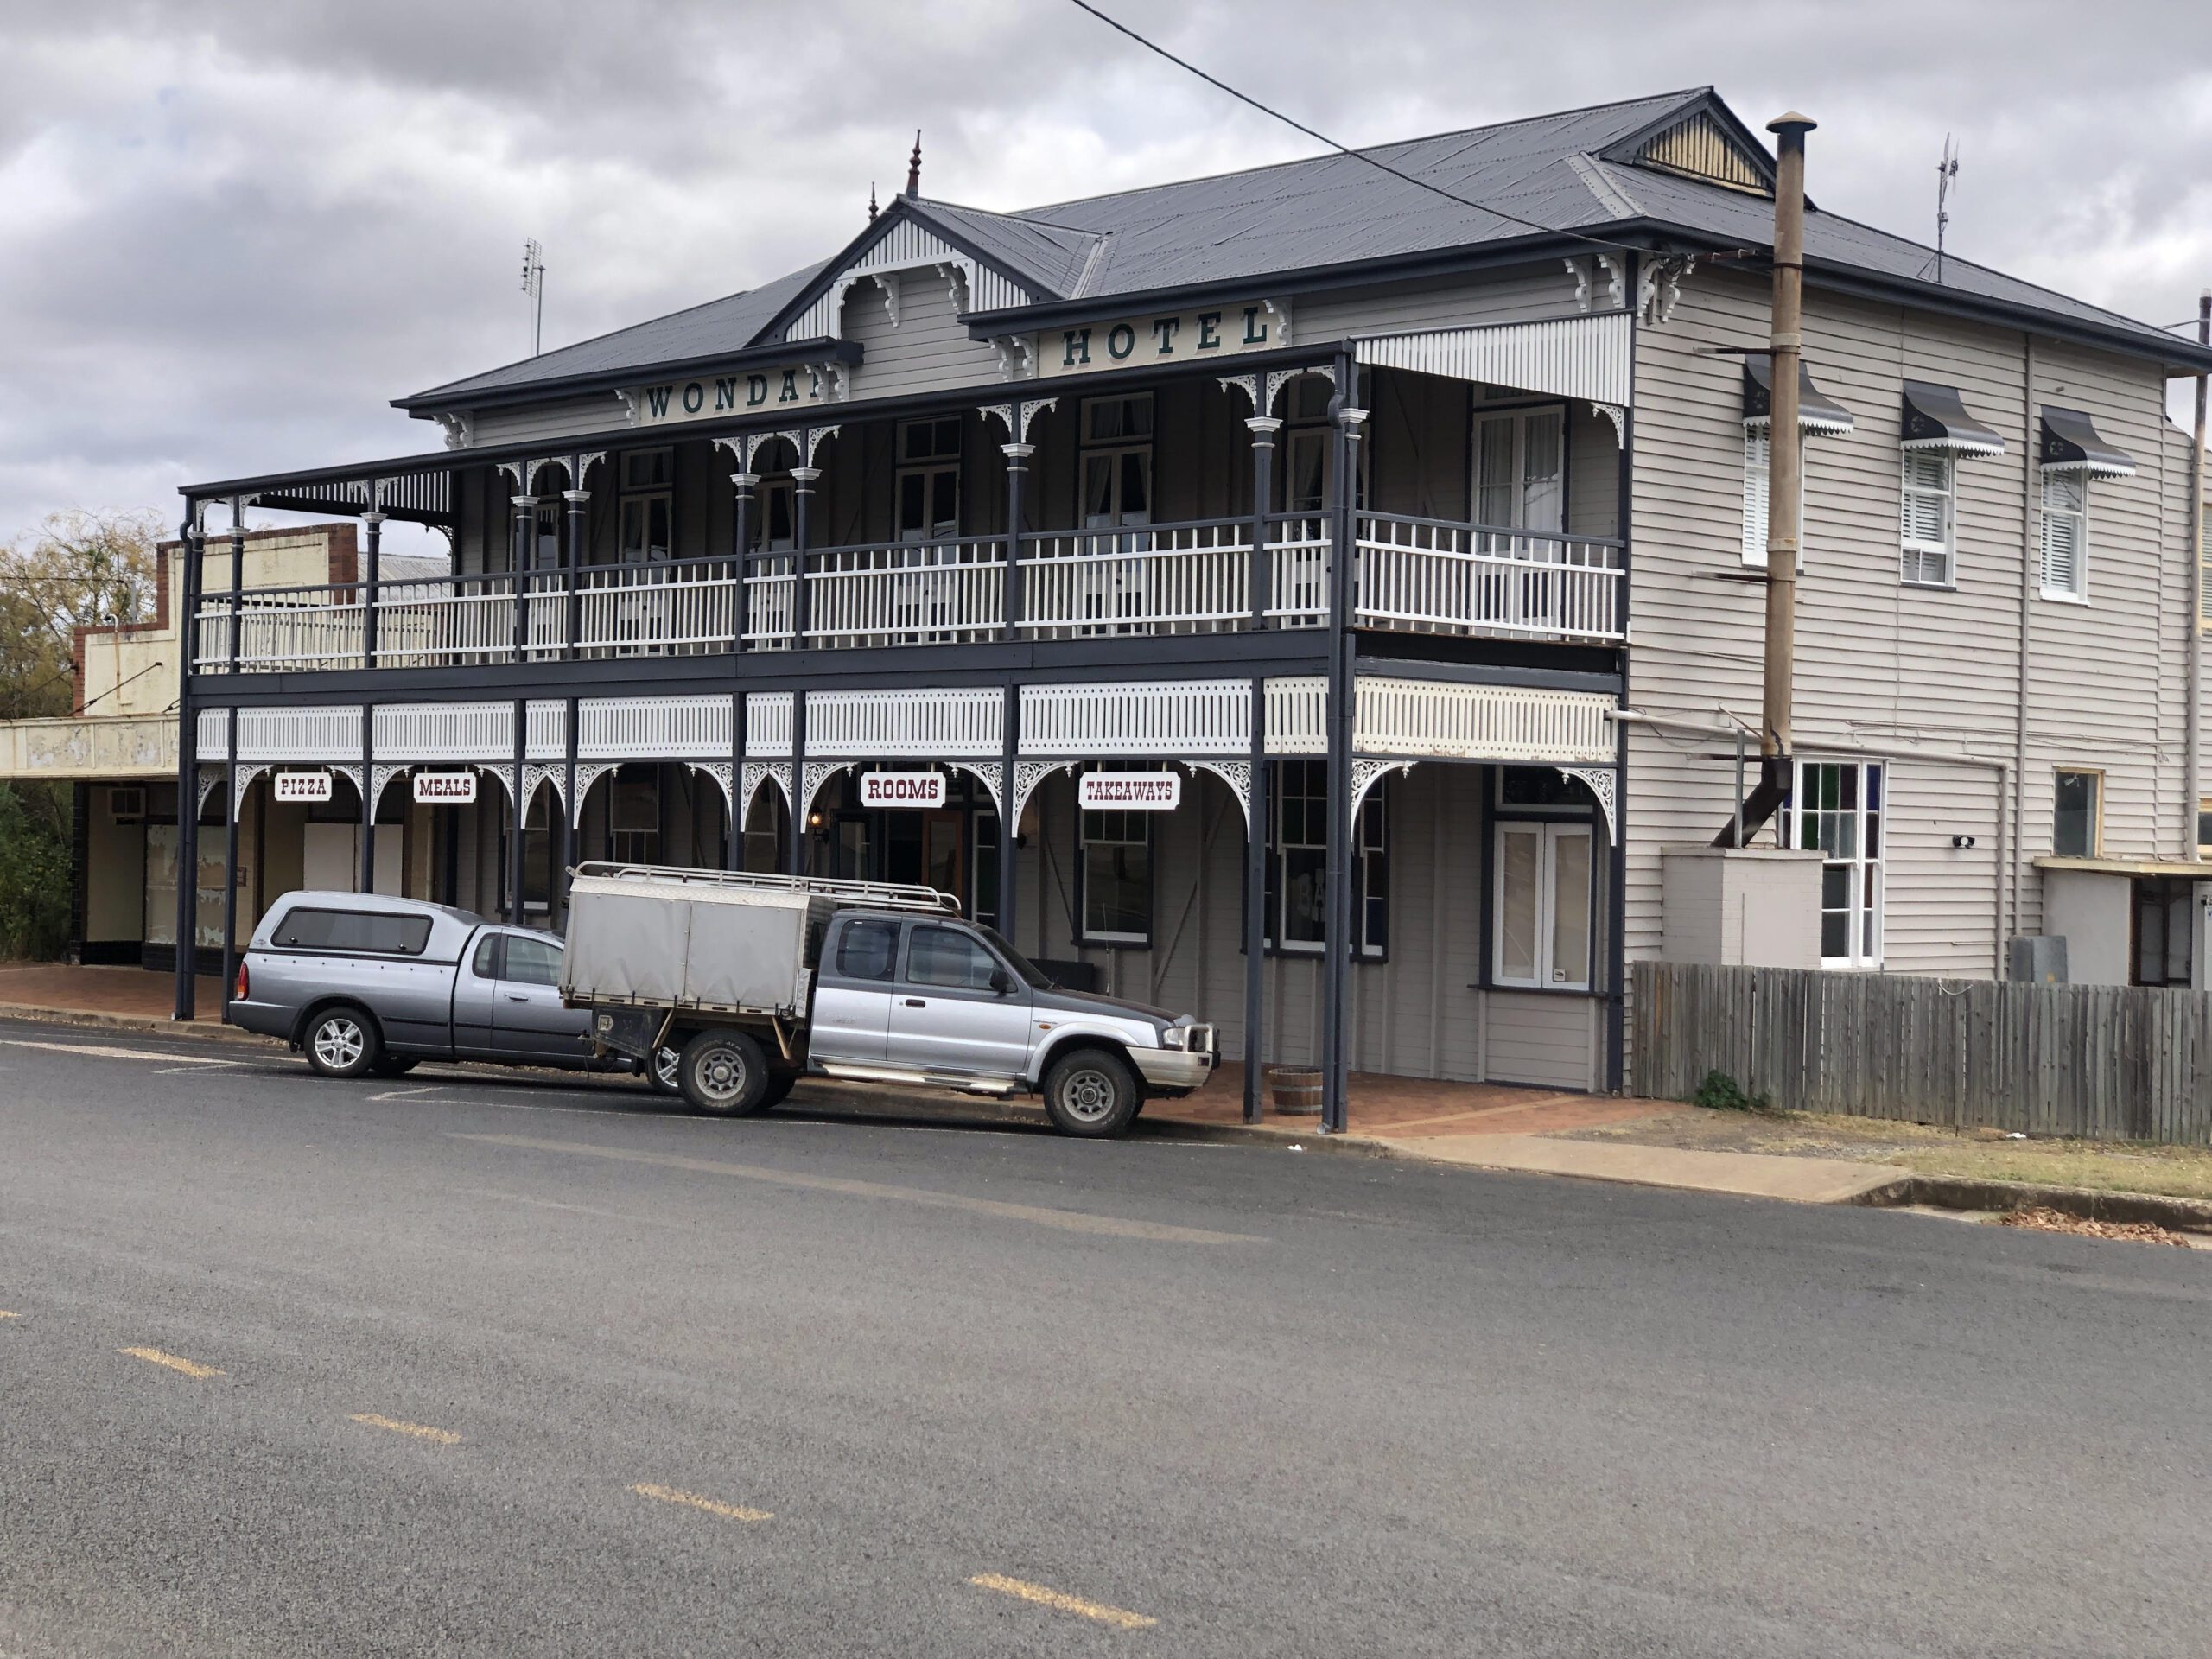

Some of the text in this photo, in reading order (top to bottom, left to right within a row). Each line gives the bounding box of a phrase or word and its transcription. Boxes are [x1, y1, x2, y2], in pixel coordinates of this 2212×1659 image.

[1062, 306, 1268, 367] HOTEL
[281, 779, 327, 795] PIZZA
[419, 779, 471, 797] MEALS
[868, 779, 938, 800] ROOMS
[1086, 780, 1173, 801] TAKEAWAYS
[1298, 868, 1326, 922] BA
